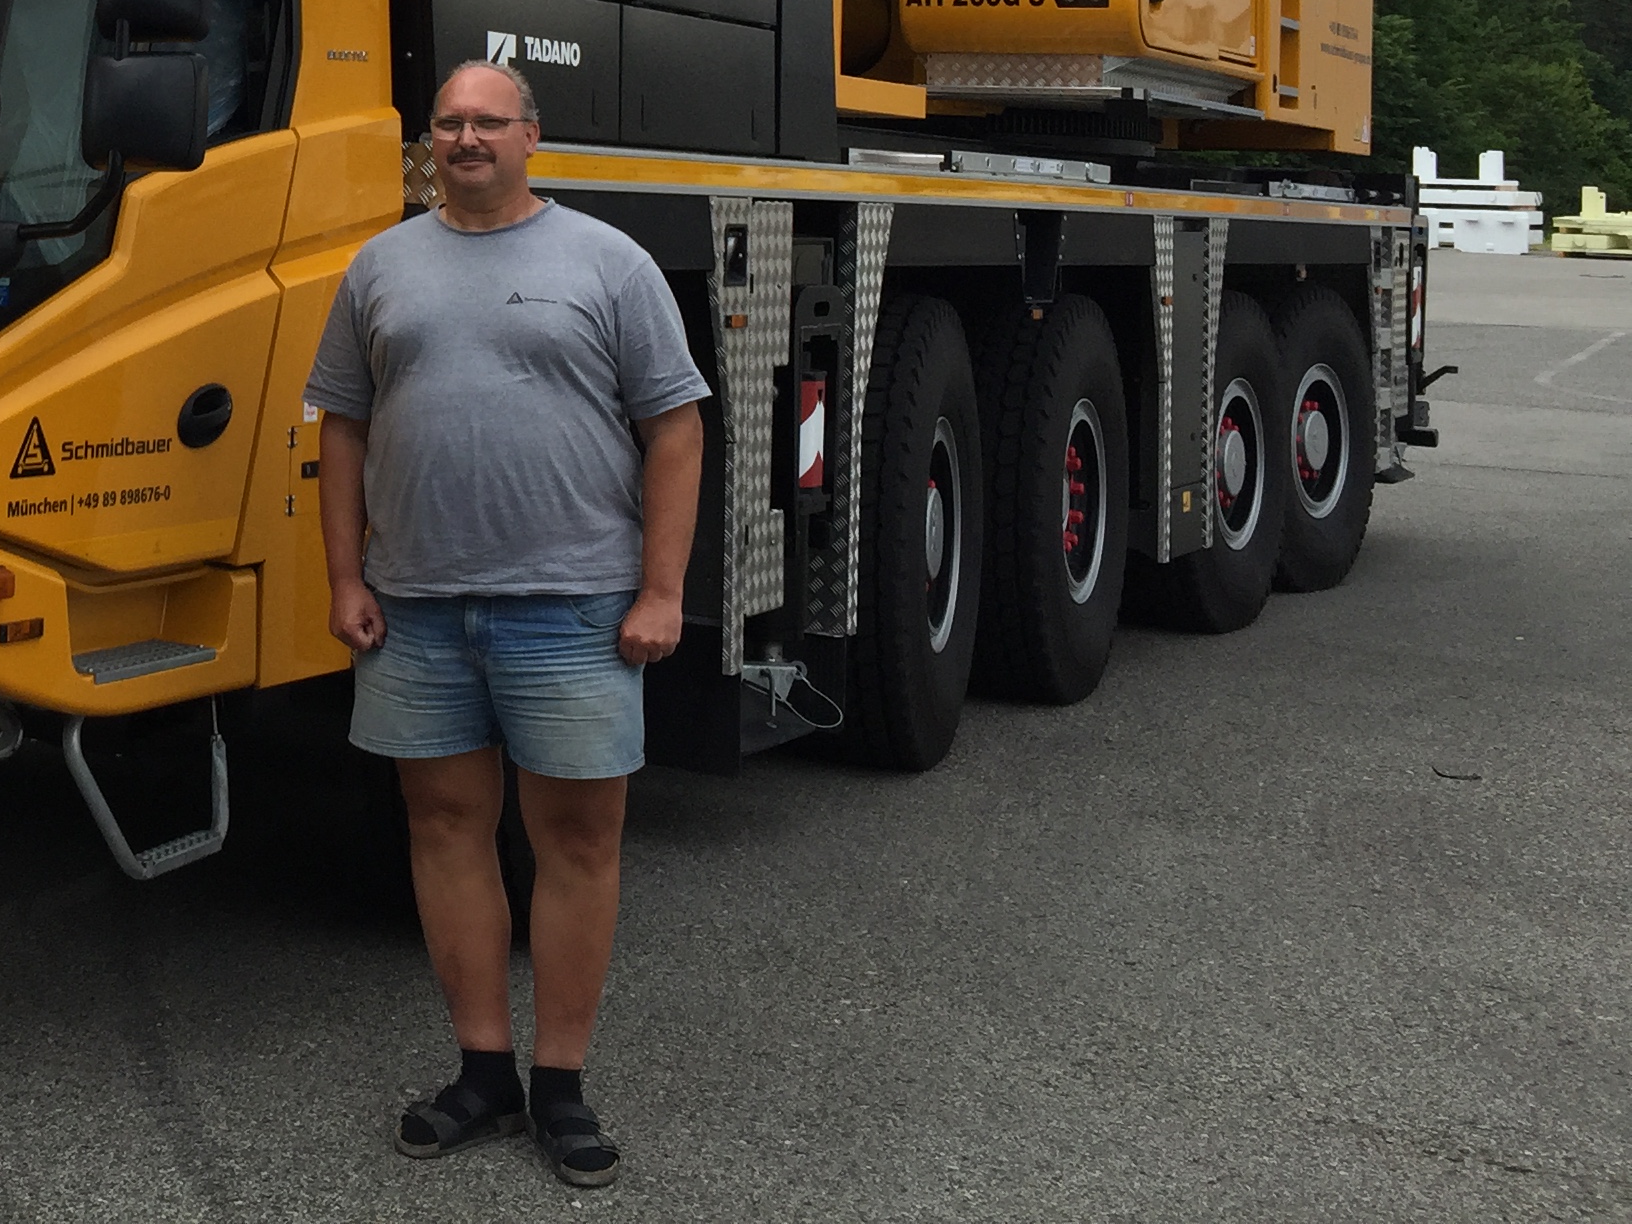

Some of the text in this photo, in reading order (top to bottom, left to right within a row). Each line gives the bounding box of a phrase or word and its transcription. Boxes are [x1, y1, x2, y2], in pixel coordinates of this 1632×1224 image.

[525, 36, 580, 67] TADANO
[61, 437, 172, 461] Schmidbauer
[7, 497, 67, 518] München
[77, 493, 99, 510] +49
[102, 491, 116, 507] 89
[120, 485, 170, 505] 898676-0
